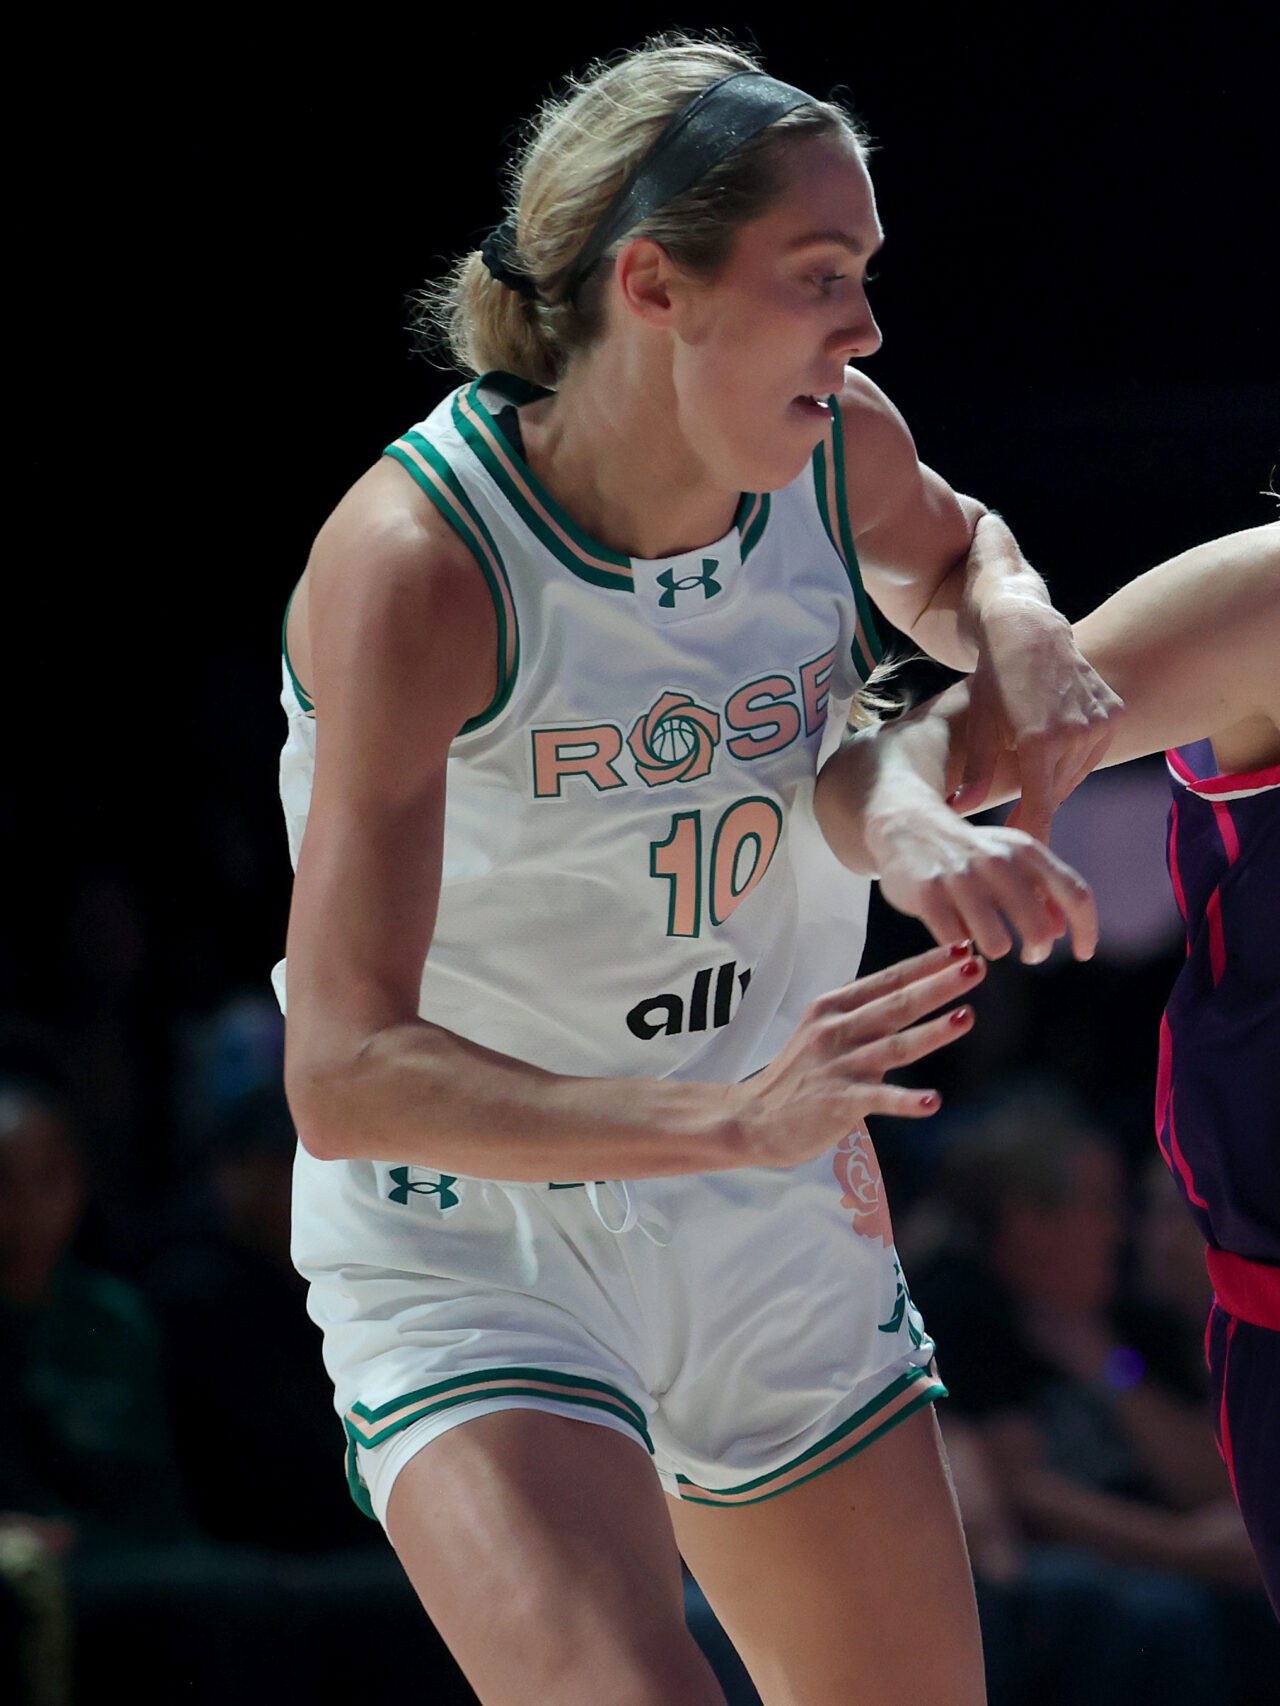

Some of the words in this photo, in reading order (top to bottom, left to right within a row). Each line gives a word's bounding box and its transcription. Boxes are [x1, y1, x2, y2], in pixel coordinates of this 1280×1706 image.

[531, 650, 836, 798] ROSE
[650, 795, 782, 938] 10
[626, 961, 752, 1040] all
